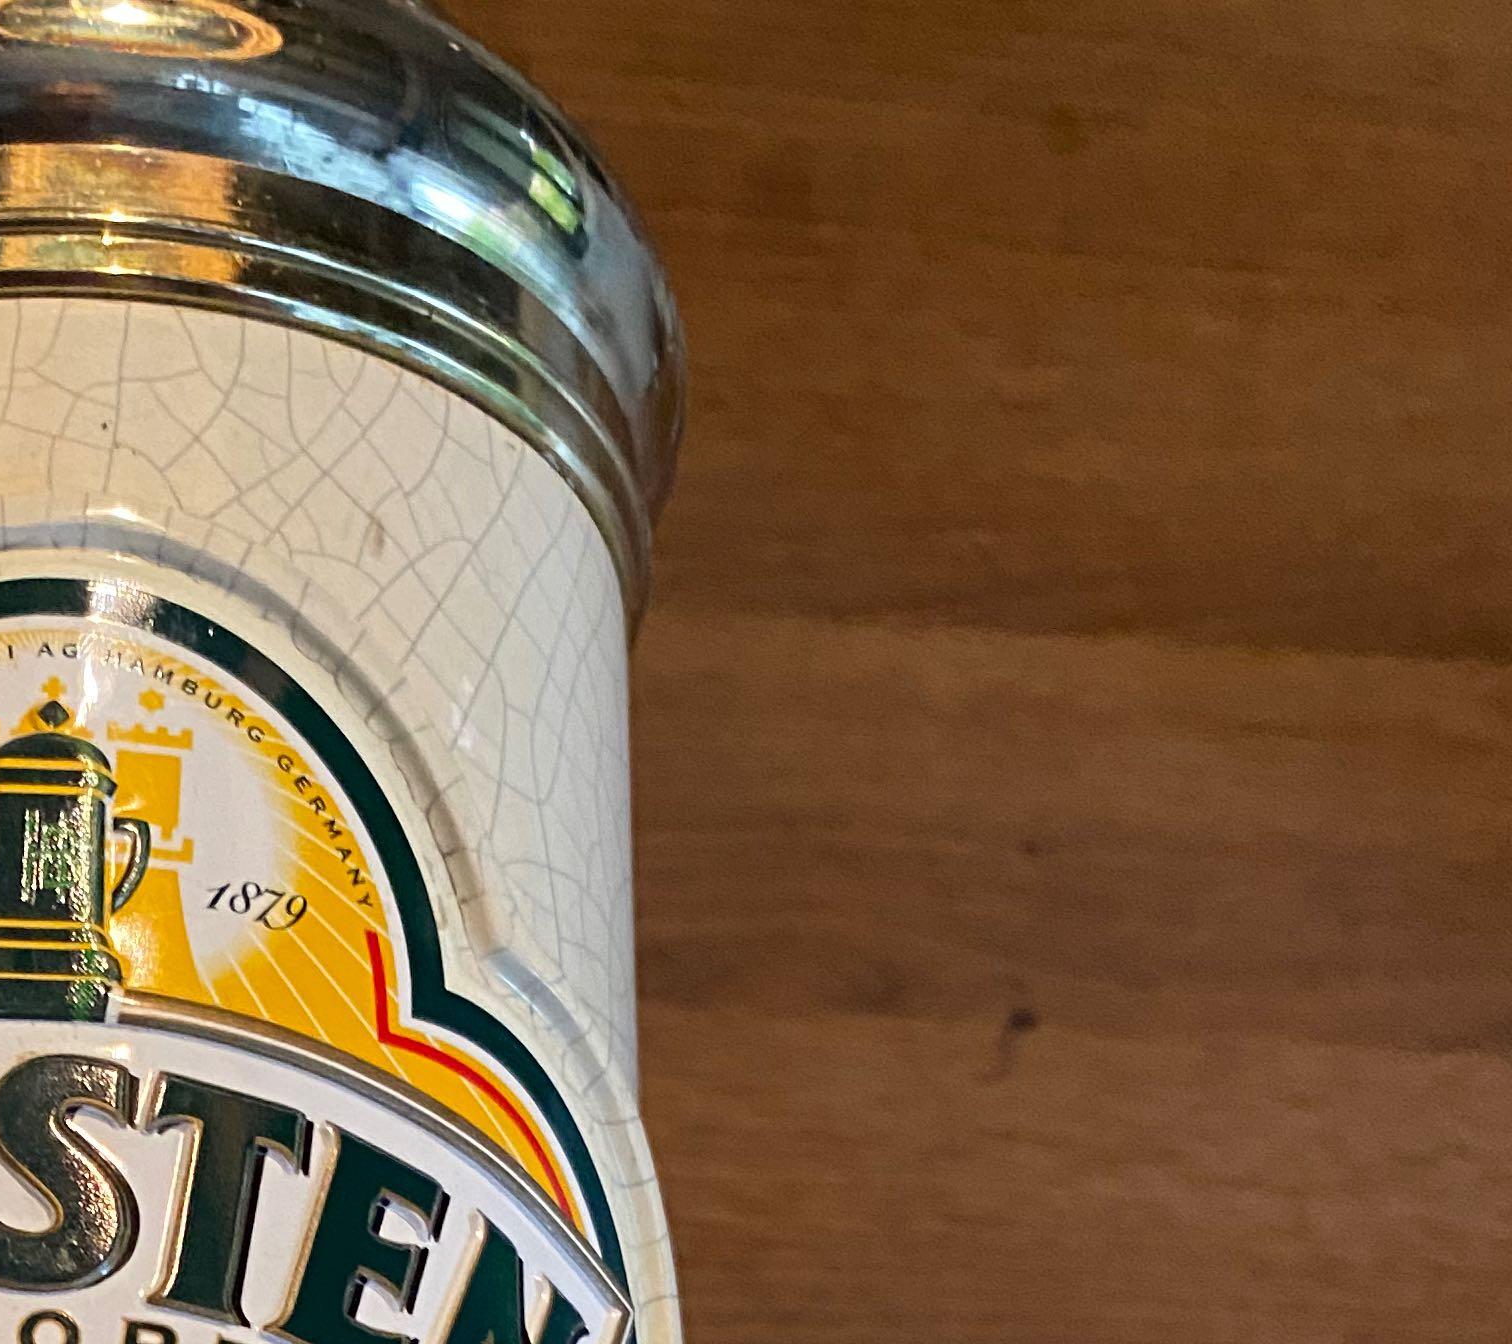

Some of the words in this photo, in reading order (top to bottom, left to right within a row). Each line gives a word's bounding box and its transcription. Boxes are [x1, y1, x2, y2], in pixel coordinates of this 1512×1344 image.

[37, 643, 81, 659] AG
[104, 648, 266, 745] HAMBURG
[276, 753, 374, 909] GERMANY
[205, 880, 308, 931] 1879
